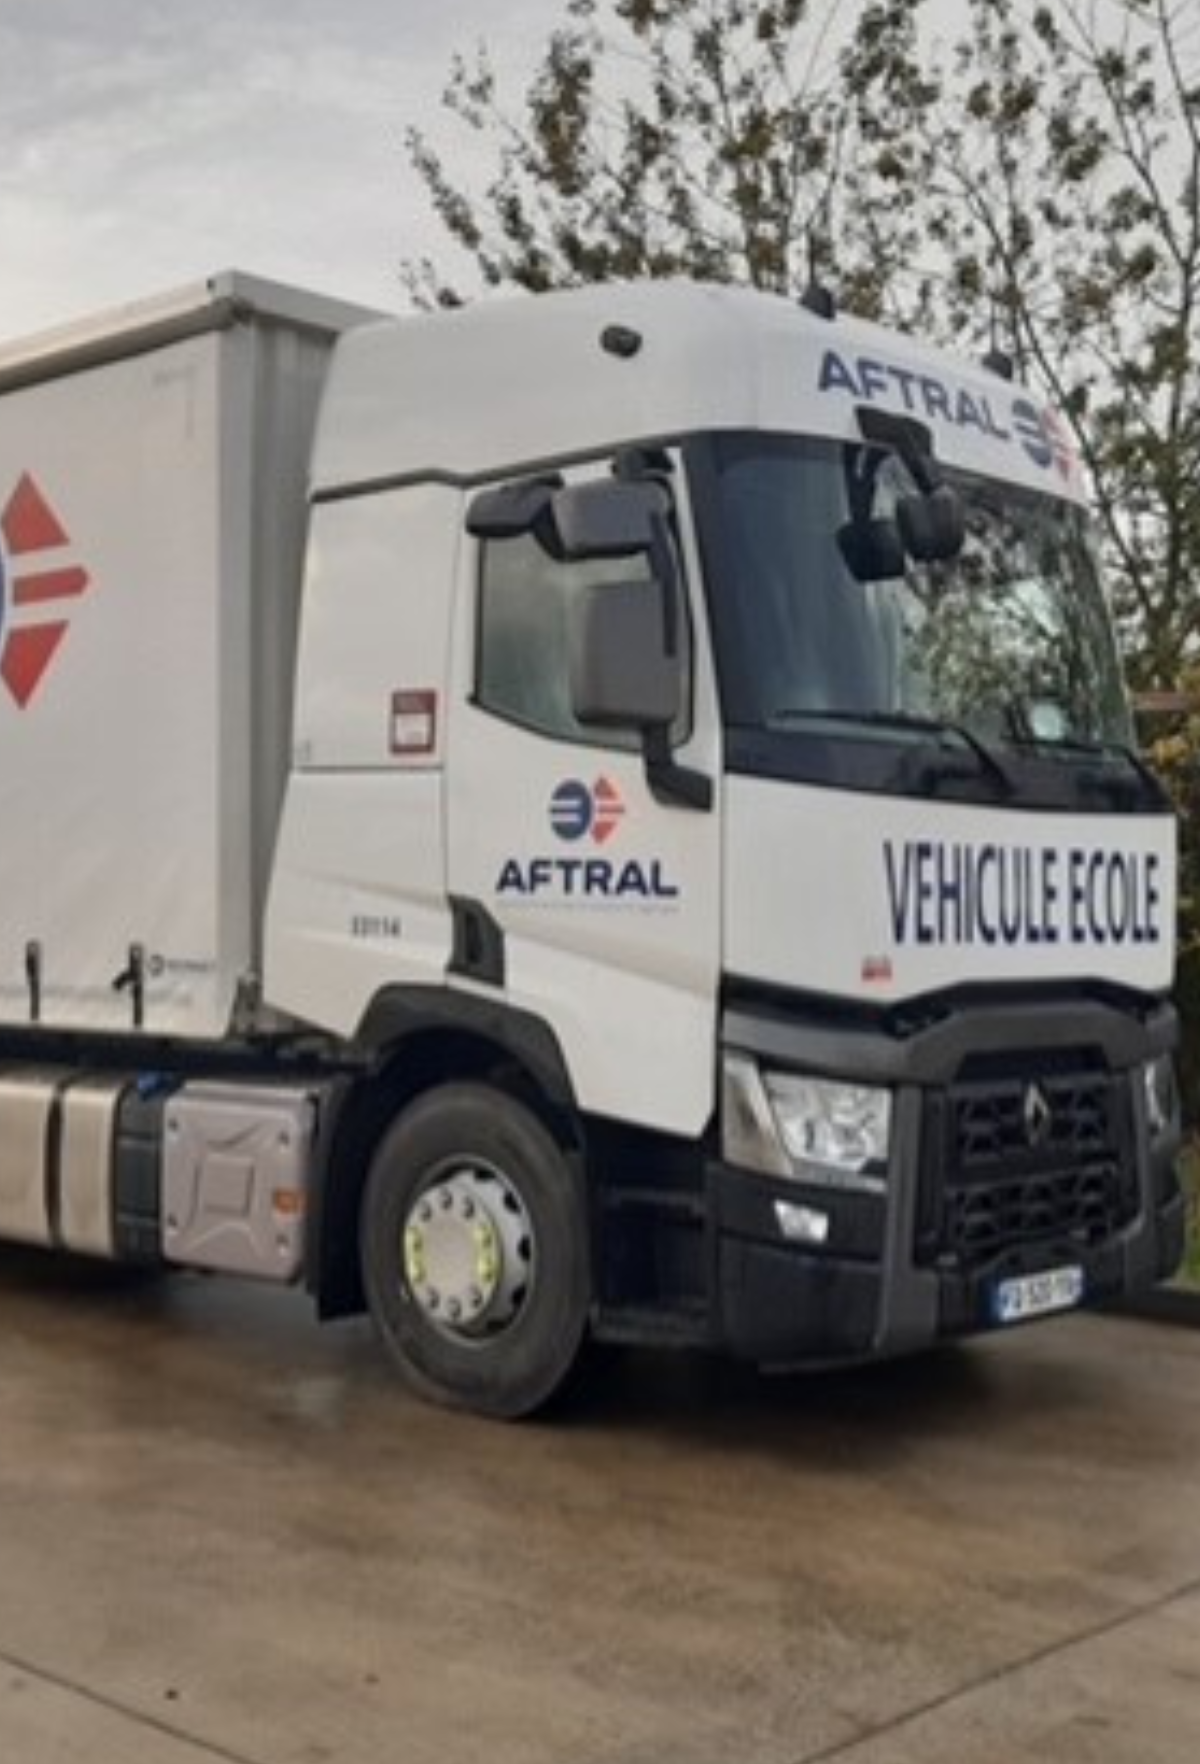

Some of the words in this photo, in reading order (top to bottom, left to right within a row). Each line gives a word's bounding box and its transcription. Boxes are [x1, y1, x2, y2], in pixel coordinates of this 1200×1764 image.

[818, 350, 1010, 441] AFTRAL
[495, 858, 679, 896] AFTRAL
[883, 839, 1059, 945] VEHICULE
[1068, 847, 1158, 944] ECOLE
